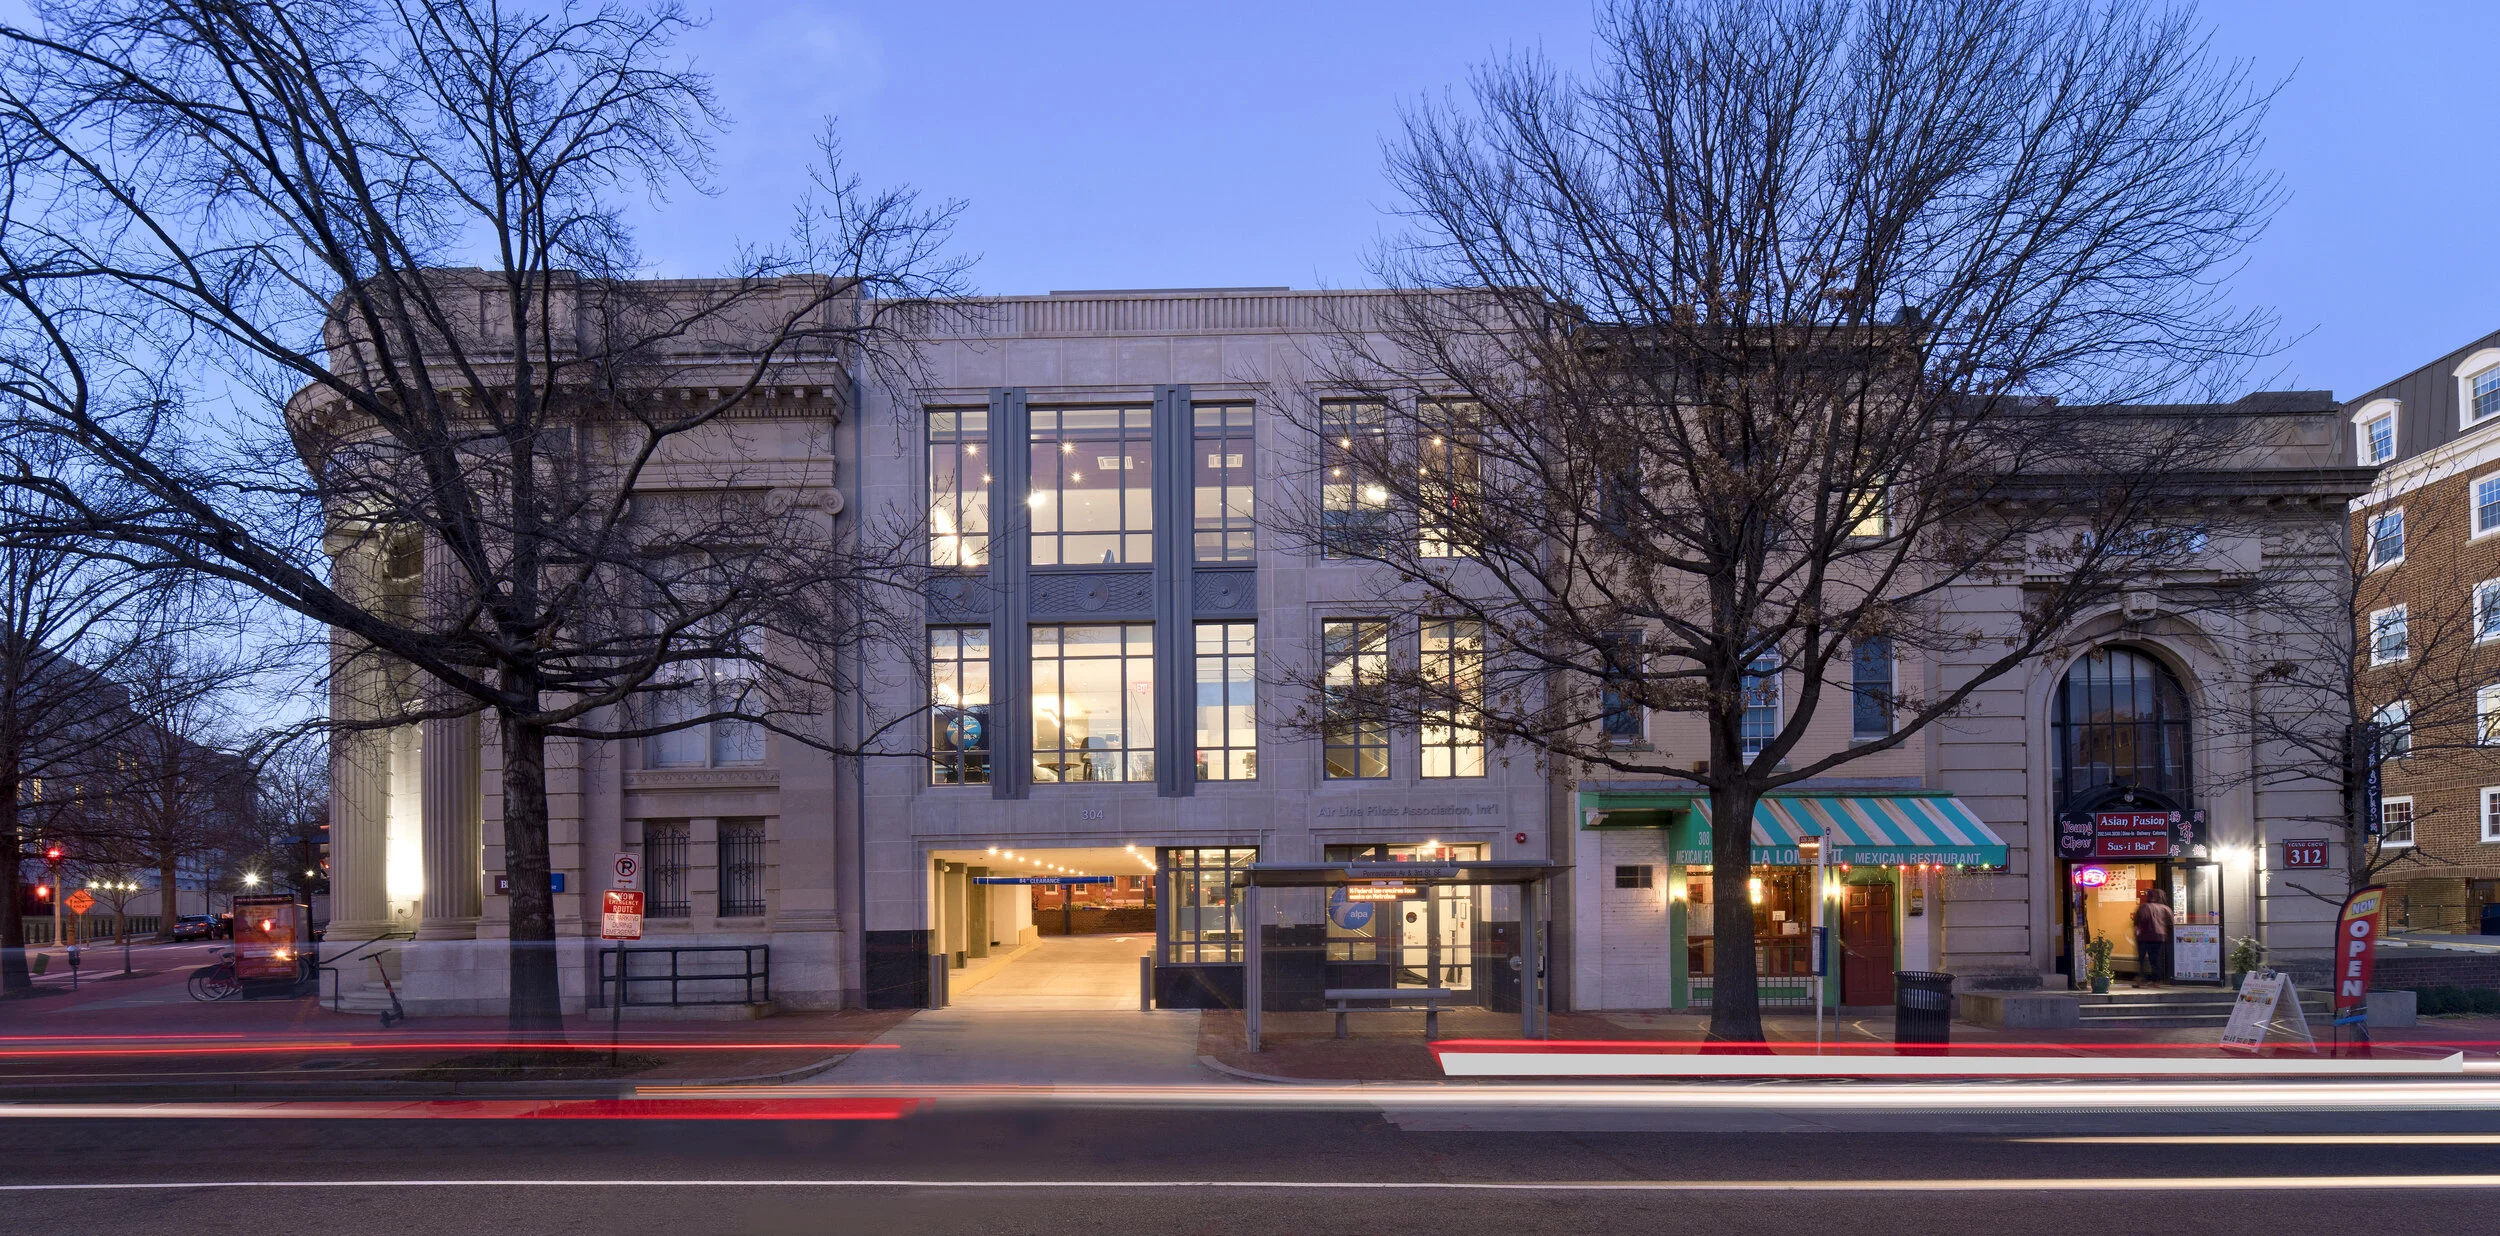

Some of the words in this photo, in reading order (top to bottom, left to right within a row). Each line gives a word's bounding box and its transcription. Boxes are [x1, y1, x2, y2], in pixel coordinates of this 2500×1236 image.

[1081, 809, 1104, 820] 304
[1318, 806, 1336, 817] Air
[1338, 806, 1364, 817] Line
[1367, 806, 1399, 817] Pilots
[1401, 804, 1473, 817] Association,
[1476, 803, 1498, 815] Int'l
[2100, 815, 2128, 826] Asian
[2132, 815, 2165, 827] Fusion
[2062, 821, 2093, 836] Young
[1698, 831, 1710, 846] 308
[2061, 836, 2092, 851] Chow
[1676, 850, 1701, 864] MEXICAN
[1752, 849, 1771, 864] LA
[1855, 852, 1904, 864] MEXICAN
[1909, 852, 1981, 864] RESTAURANT
[2290, 849, 2322, 864] 312
[612, 905, 634, 913] ROUTE
[2352, 898, 2377, 915] NOW
[1350, 910, 1368, 920] alpa
[2341, 920, 2370, 997] OPEN
